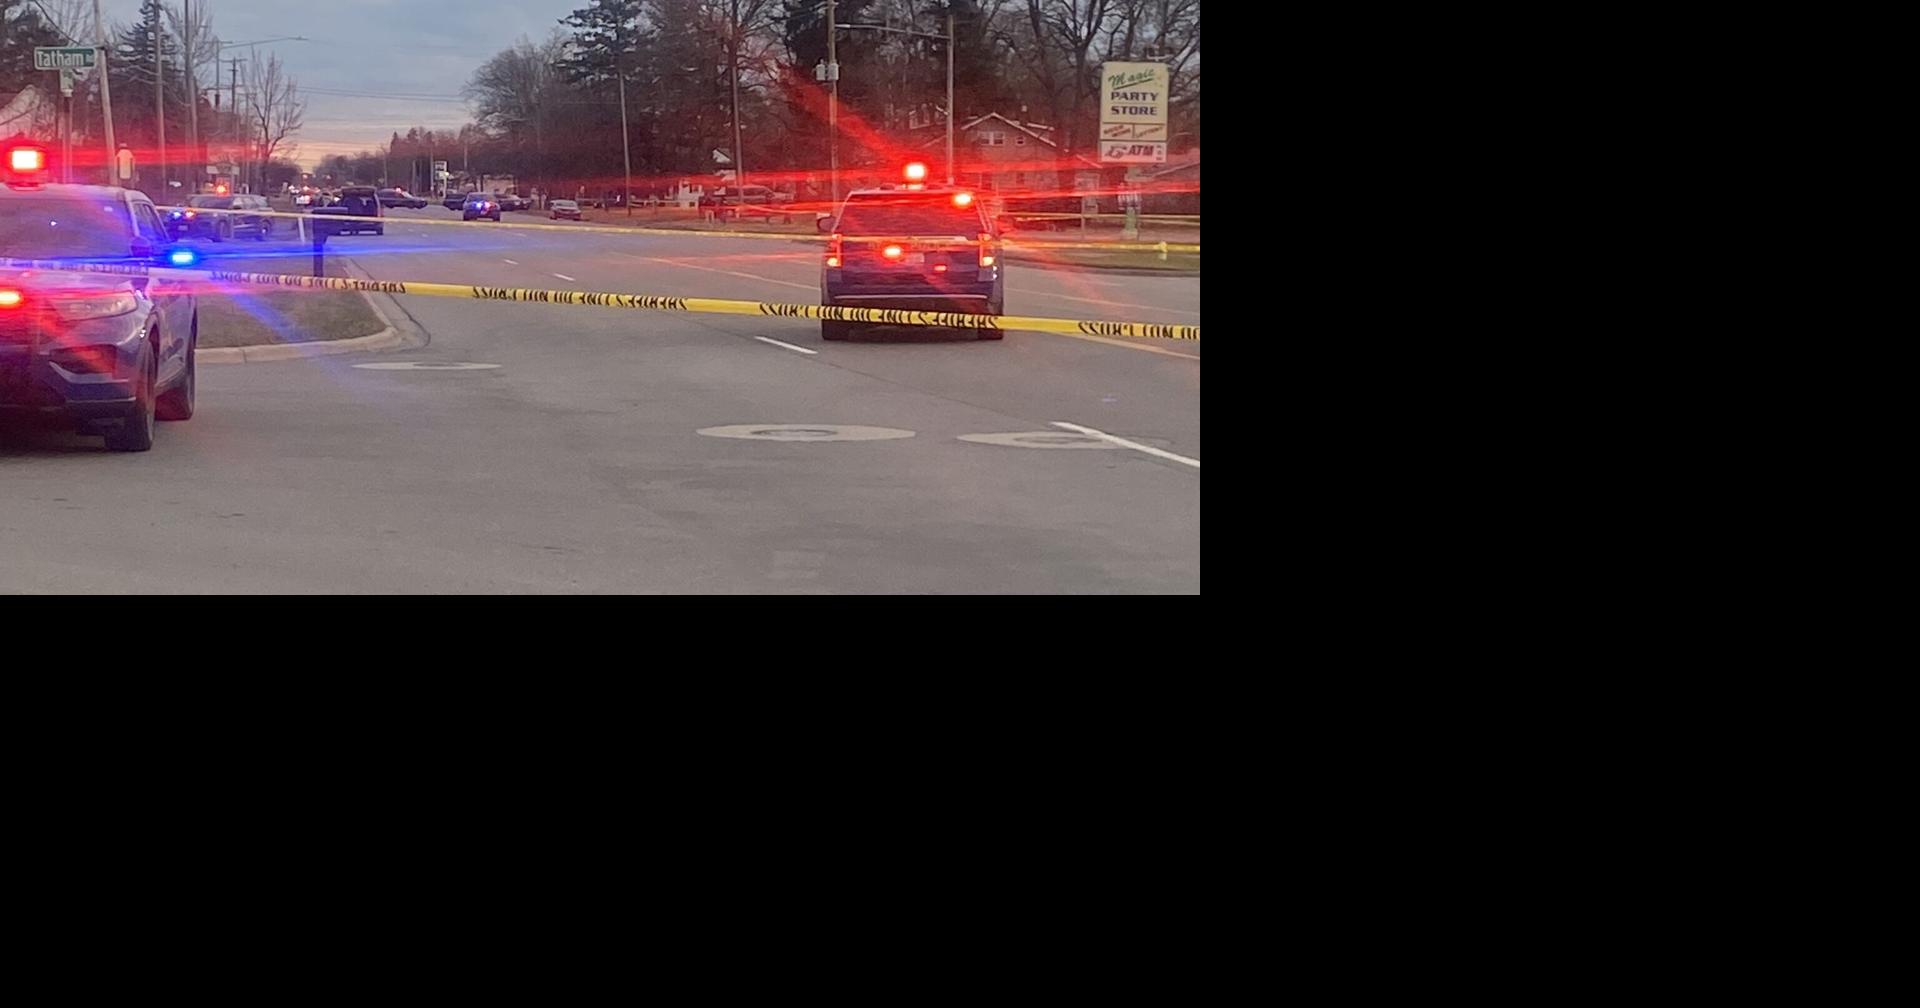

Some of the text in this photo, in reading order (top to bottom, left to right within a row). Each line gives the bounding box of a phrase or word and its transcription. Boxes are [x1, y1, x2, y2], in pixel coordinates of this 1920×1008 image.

[37, 50, 84, 67] Tatham
[1111, 92, 1158, 102] PARTY
[1111, 106, 1158, 115] STORE
[1128, 145, 1154, 155] ATM
